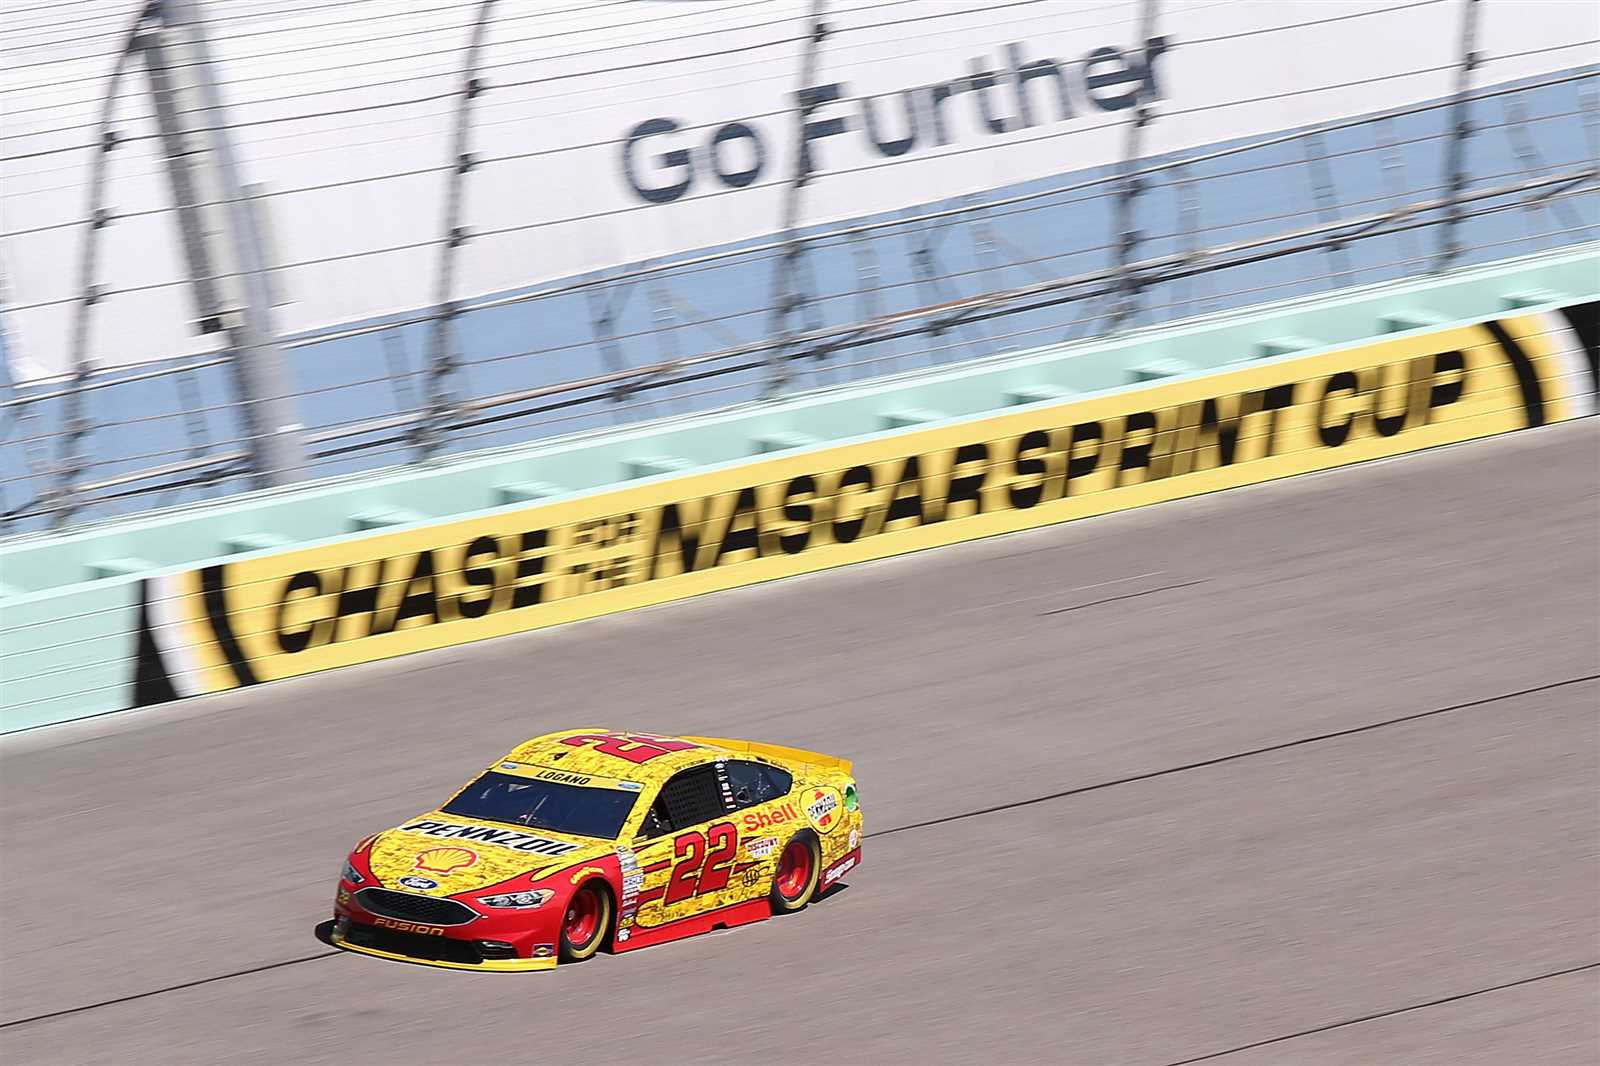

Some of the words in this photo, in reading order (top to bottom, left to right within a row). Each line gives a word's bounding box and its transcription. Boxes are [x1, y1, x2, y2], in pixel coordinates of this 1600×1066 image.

[621, 117, 767, 203] Go
[795, 36, 1170, 185] Further
[274, 529, 549, 654] CHASE
[645, 443, 989, 581] NASCAR
[1008, 383, 1296, 509] SPRINT
[1317, 349, 1467, 447] CUP
[535, 770, 592, 786] LOGANO
[743, 803, 797, 831] Shell
[402, 820, 579, 856] PENNZOIL
[663, 821, 738, 907] 22
[402, 877, 436, 889] Ford
[373, 918, 445, 936] FUSION
